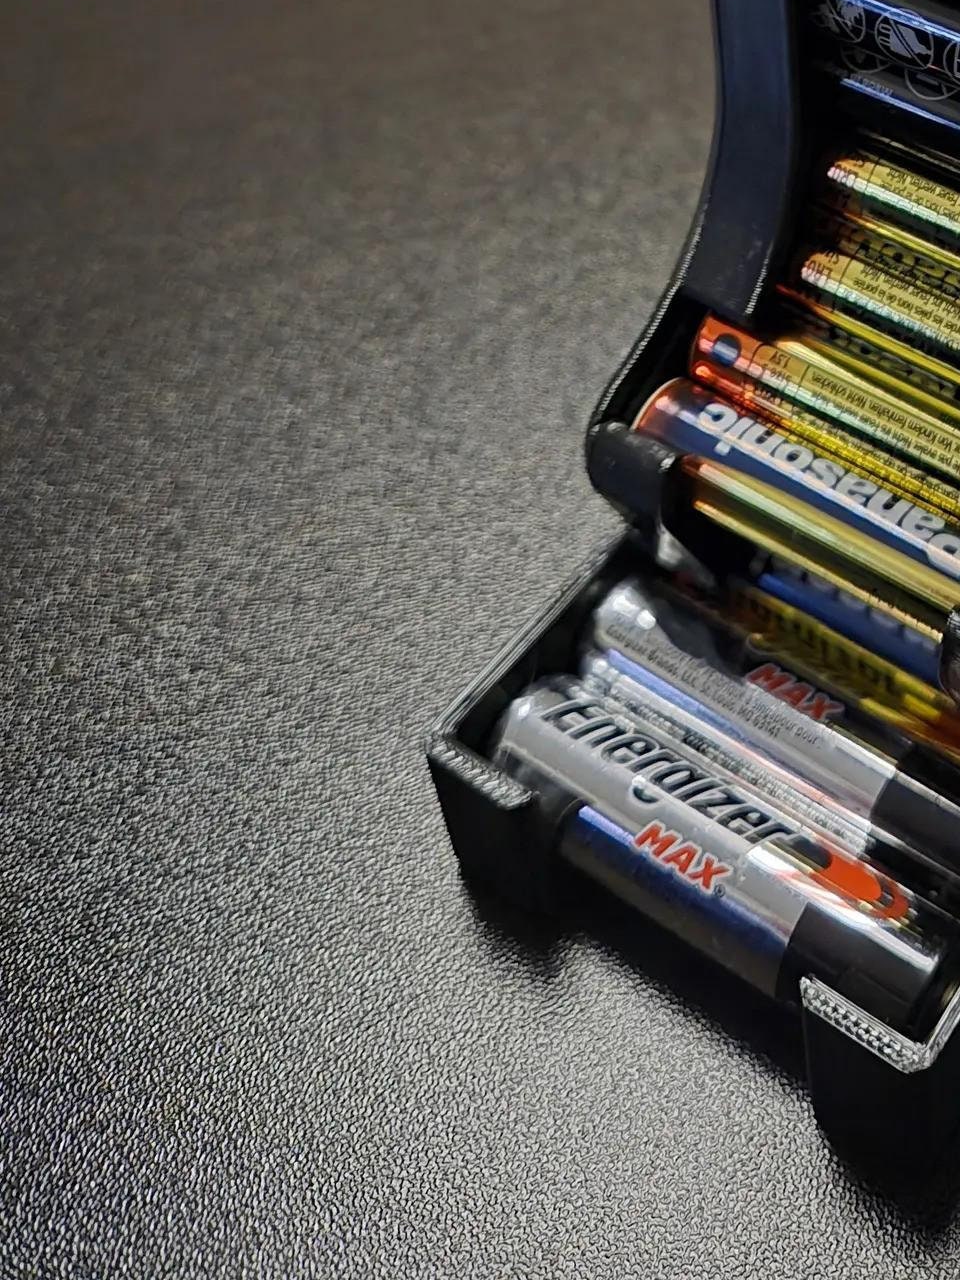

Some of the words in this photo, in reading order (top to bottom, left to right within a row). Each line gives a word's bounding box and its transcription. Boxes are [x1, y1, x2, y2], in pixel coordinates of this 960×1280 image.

[928, 314, 943, 330] les
[768, 349, 791, 368] 1.5V
[935, 433, 955, 452] Von
[747, 662, 845, 720] MAX
[540, 700, 796, 842] Energizer
